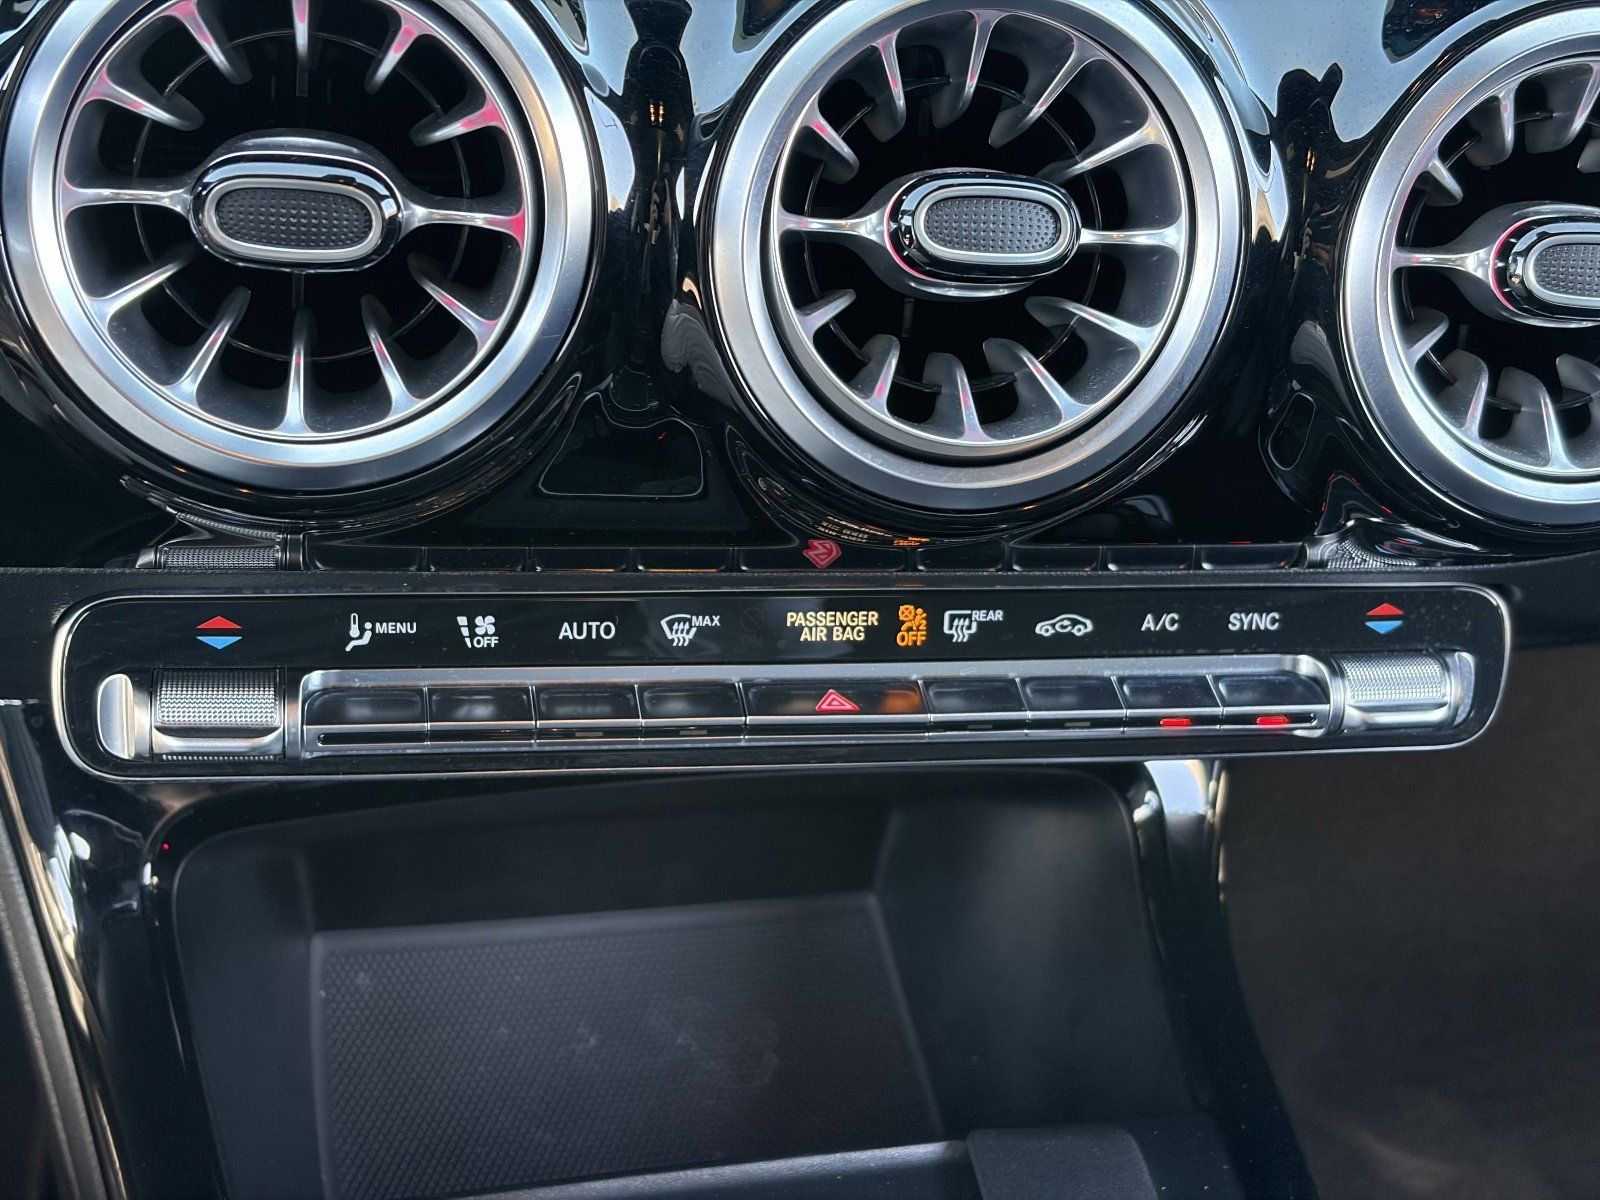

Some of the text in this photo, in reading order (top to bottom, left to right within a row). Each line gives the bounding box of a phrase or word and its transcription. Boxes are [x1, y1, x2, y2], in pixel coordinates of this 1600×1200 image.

[691, 615, 721, 628] MAX
[786, 611, 879, 626] PASSENGER
[972, 609, 1004, 622] REAR
[1140, 612, 1179, 632] A/C
[1227, 611, 1280, 631] SYNC
[375, 621, 417, 634] MENU
[558, 621, 616, 640] AUTO
[799, 626, 865, 642] AIR BAG
[473, 636, 499, 649] OFF
[896, 631, 927, 647] OFF
